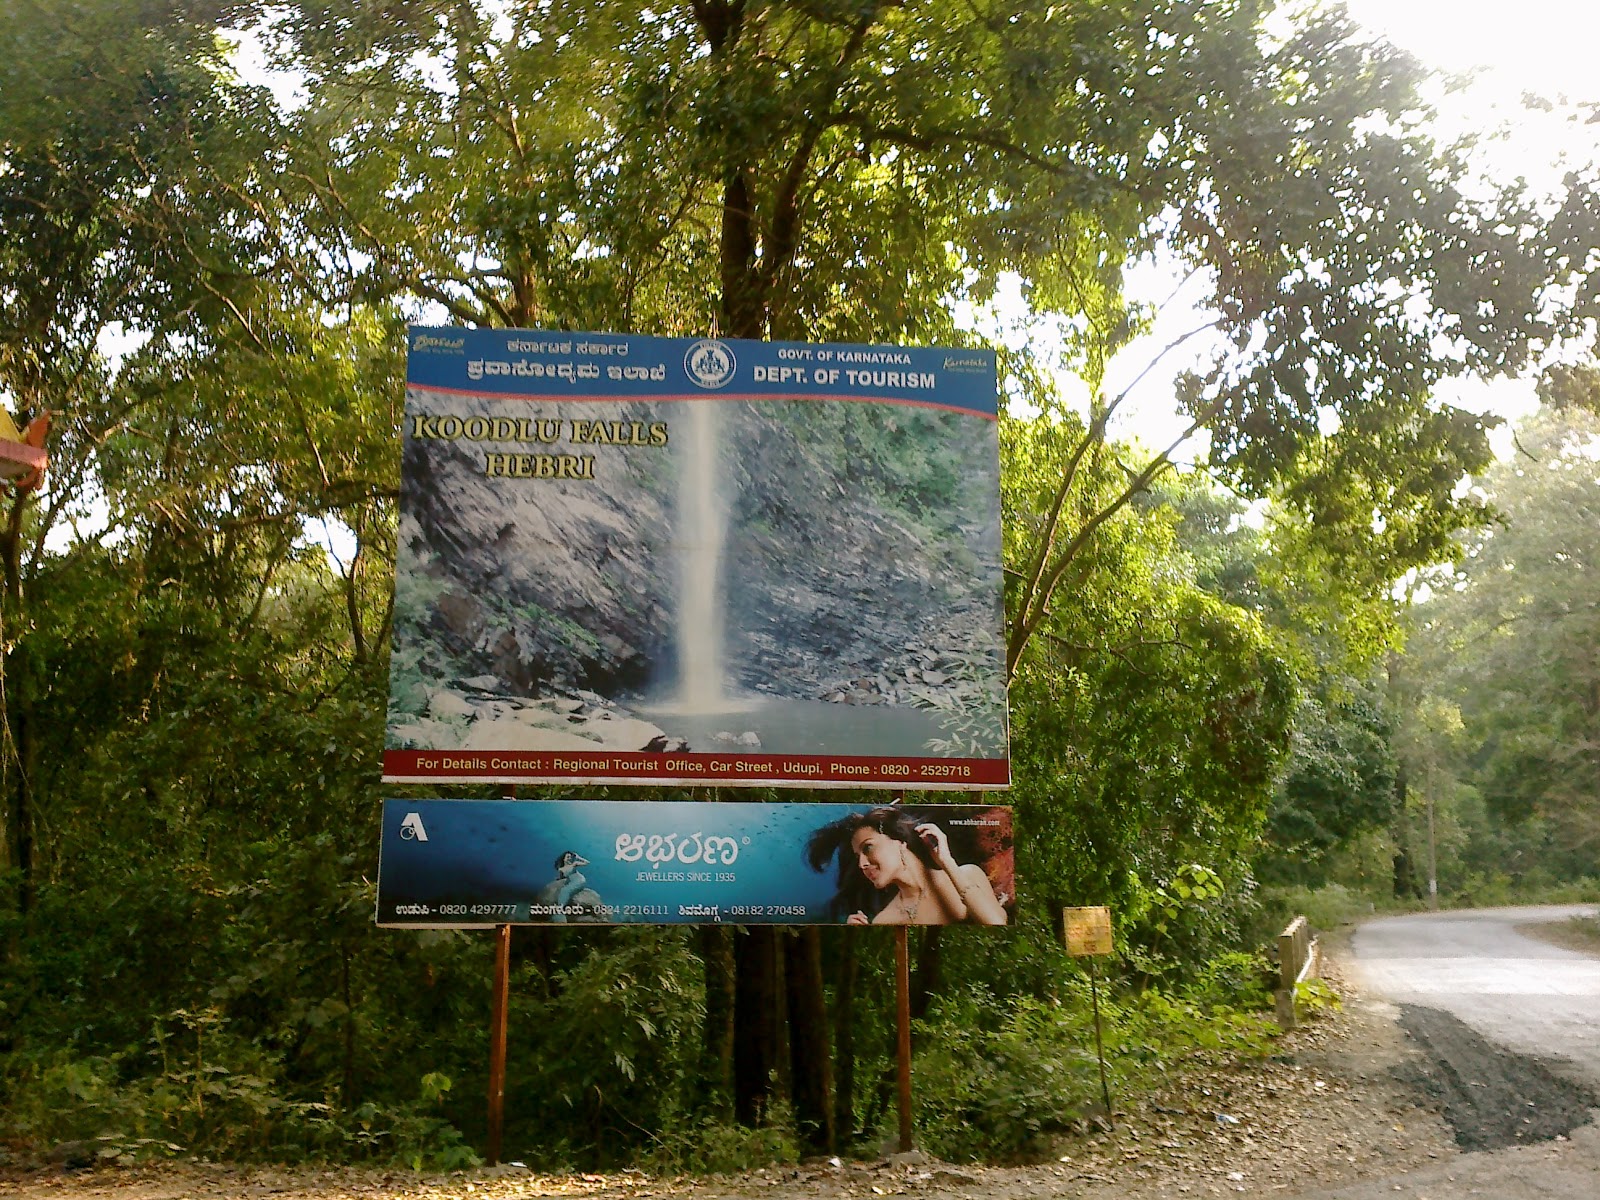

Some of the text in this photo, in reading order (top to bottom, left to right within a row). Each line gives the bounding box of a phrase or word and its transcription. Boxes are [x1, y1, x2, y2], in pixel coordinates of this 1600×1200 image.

[507, 339, 629, 357] ಕರ್ನಾಟಕ ಸರ್ಕಾರ
[778, 348, 911, 365] GOVT. OF KARNATAKA
[467, 358, 666, 384] ಪ್ರವಾಸೋದ್ಯಮ ಇಲಾಖೆ
[753, 365, 936, 389] DEPT. OF TOURISM
[412, 415, 668, 446] KOODLU FALLS
[486, 452, 595, 480] HEBRI
[416, 757, 439, 770] For
[443, 758, 487, 770] Details
[491, 758, 542, 770] Contact
[553, 758, 610, 772] Regional
[613, 759, 658, 771] Tourist
[665, 759, 706, 773] Office,
[710, 760, 731, 772] Car
[735, 761, 773, 773] Street
[783, 762, 823, 776] Udupi,
[830, 762, 870, 775] Phone
[881, 764, 910, 776] 0820
[921, 765, 971, 777] 2529718
[614, 831, 739, 869] ಆಭರಣ
[636, 872, 736, 882] JEWELLERS SINCE 1935
[395, 903, 430, 916] ಉಡುಪಿ
[440, 903, 467, 915] 0820
[470, 904, 517, 915] 4297777
[529, 903, 584, 916] ಮಂಗಳೂರು
[593, 904, 620, 915] 0824
[624, 904, 669, 915] 2216111
[731, 905, 763, 916] 08182
[767, 905, 806, 916] 270458
